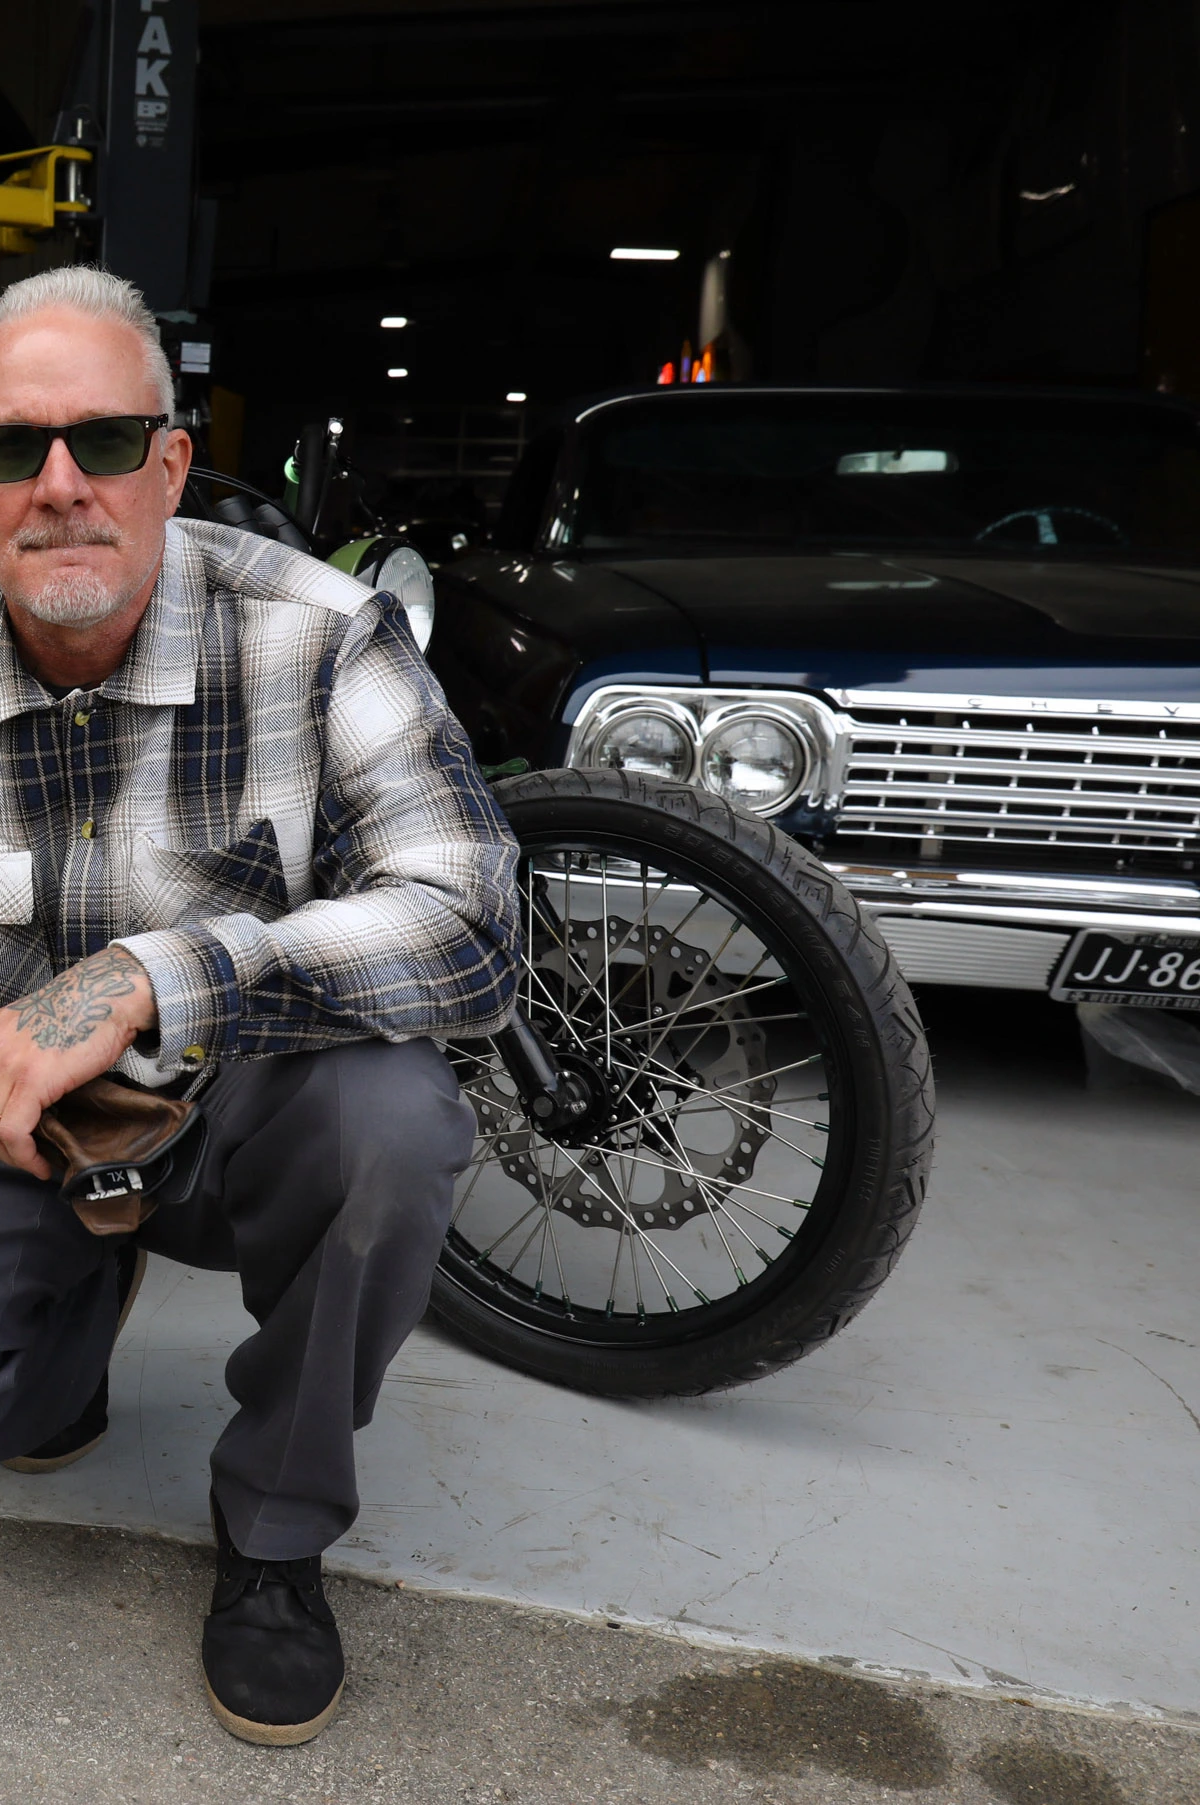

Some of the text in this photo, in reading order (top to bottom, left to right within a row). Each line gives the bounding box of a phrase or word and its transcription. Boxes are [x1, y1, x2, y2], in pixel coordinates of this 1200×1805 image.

[137, 101, 167, 118] BP
[1089, 992, 1126, 1003] WEST
[106, 1171, 126, 1182] XL
